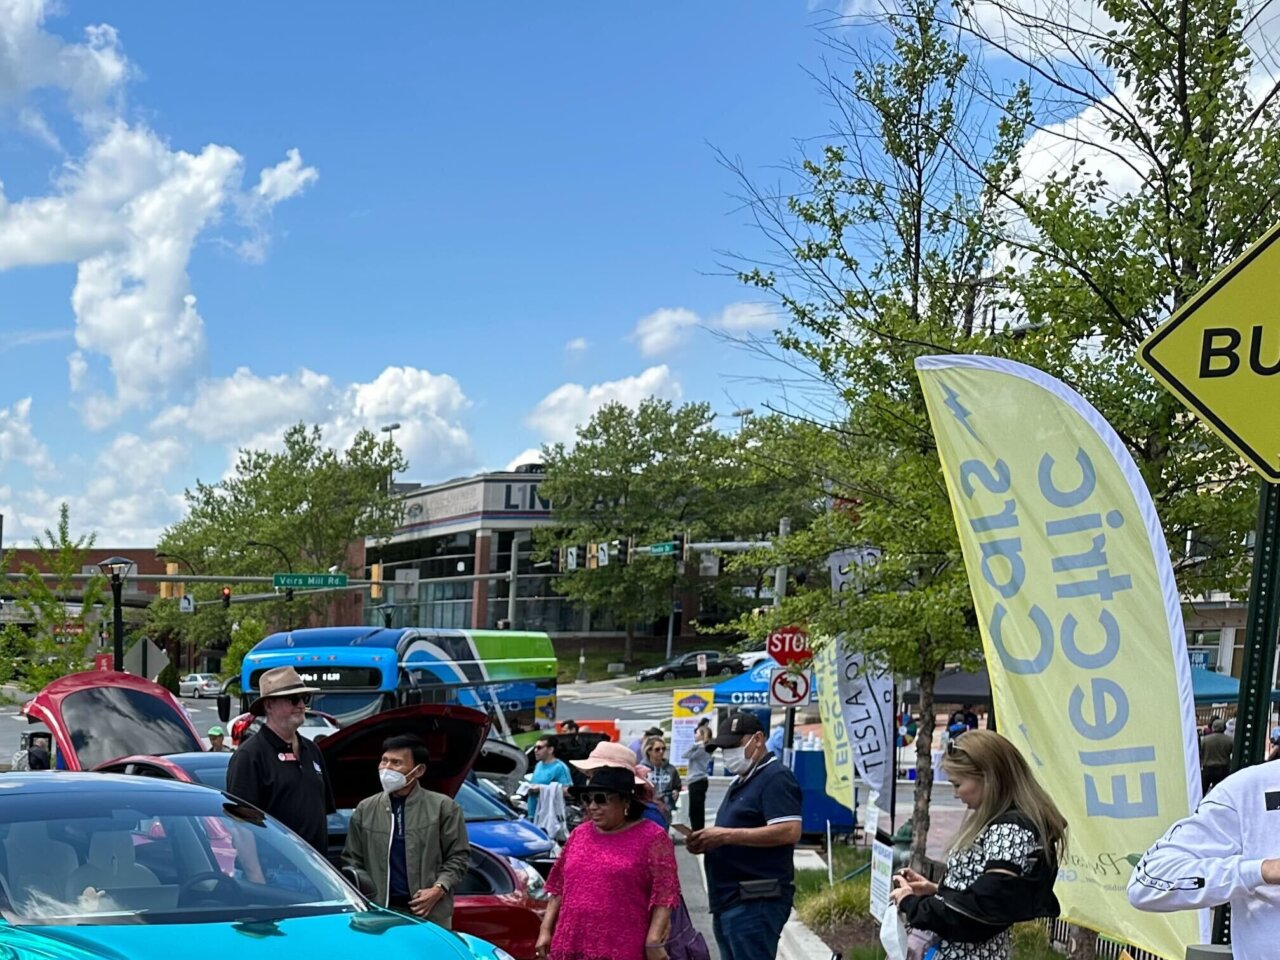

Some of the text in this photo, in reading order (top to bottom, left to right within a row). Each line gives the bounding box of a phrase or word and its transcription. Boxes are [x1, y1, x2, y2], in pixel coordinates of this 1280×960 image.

[279, 576, 342, 586] Veirs Mill Rd.
[845, 690, 883, 774] TESLA
